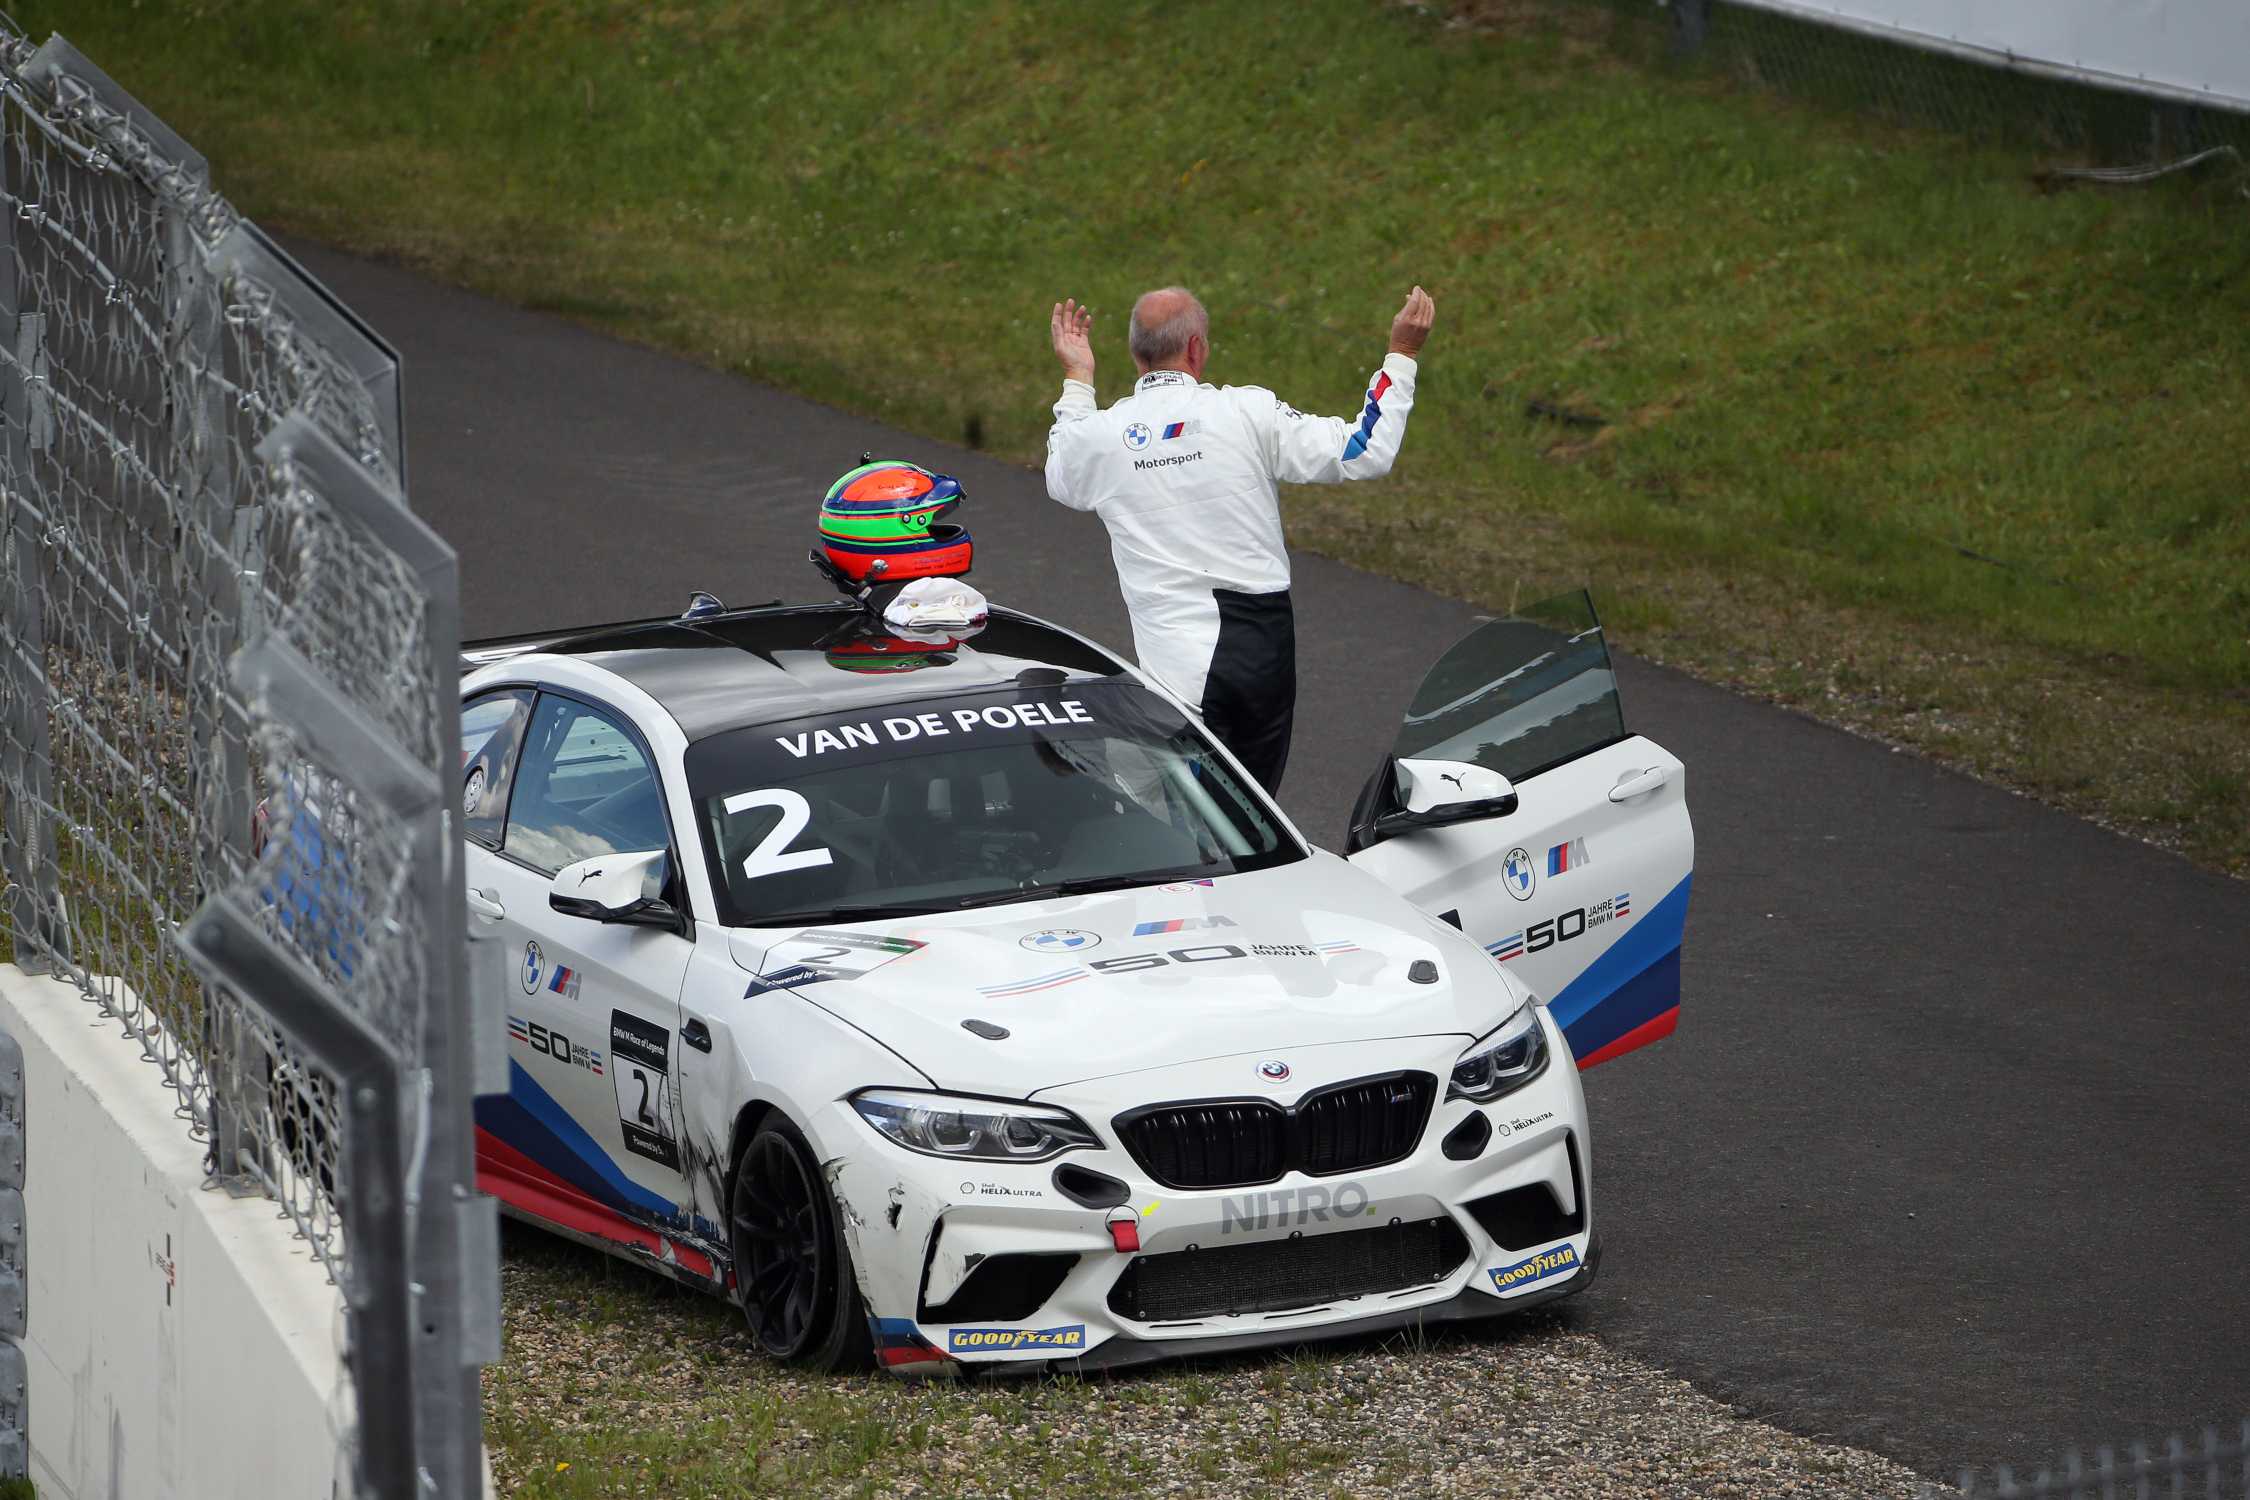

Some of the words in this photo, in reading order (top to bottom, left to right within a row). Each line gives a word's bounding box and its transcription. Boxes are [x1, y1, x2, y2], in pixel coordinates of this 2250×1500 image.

[1134, 451, 1203, 470] Motorsport
[776, 723, 880, 758] VAN
[883, 713, 950, 741] DE
[952, 701, 1094, 732] POELE
[724, 788, 833, 878] 2
[1588, 899, 1612, 917] JAHRE
[1588, 914, 1605, 928] BMW
[1607, 911, 1612, 921] M
[1526, 908, 1585, 953] 50
[798, 947, 851, 964] 2
[1089, 945, 1248, 975] 50
[804, 971, 815, 980] by
[614, 1026, 625, 1039] BMW
[528, 1021, 571, 1064] 50
[633, 1069, 654, 1127] 2
[1513, 1119, 1535, 1131] HELIX
[1534, 1112, 1554, 1123] ULTRA
[981, 1186, 1012, 1195] HELIX
[1495, 1249, 1574, 1286] GOODYEAR
[954, 1330, 1080, 1348] GOODYEAR
